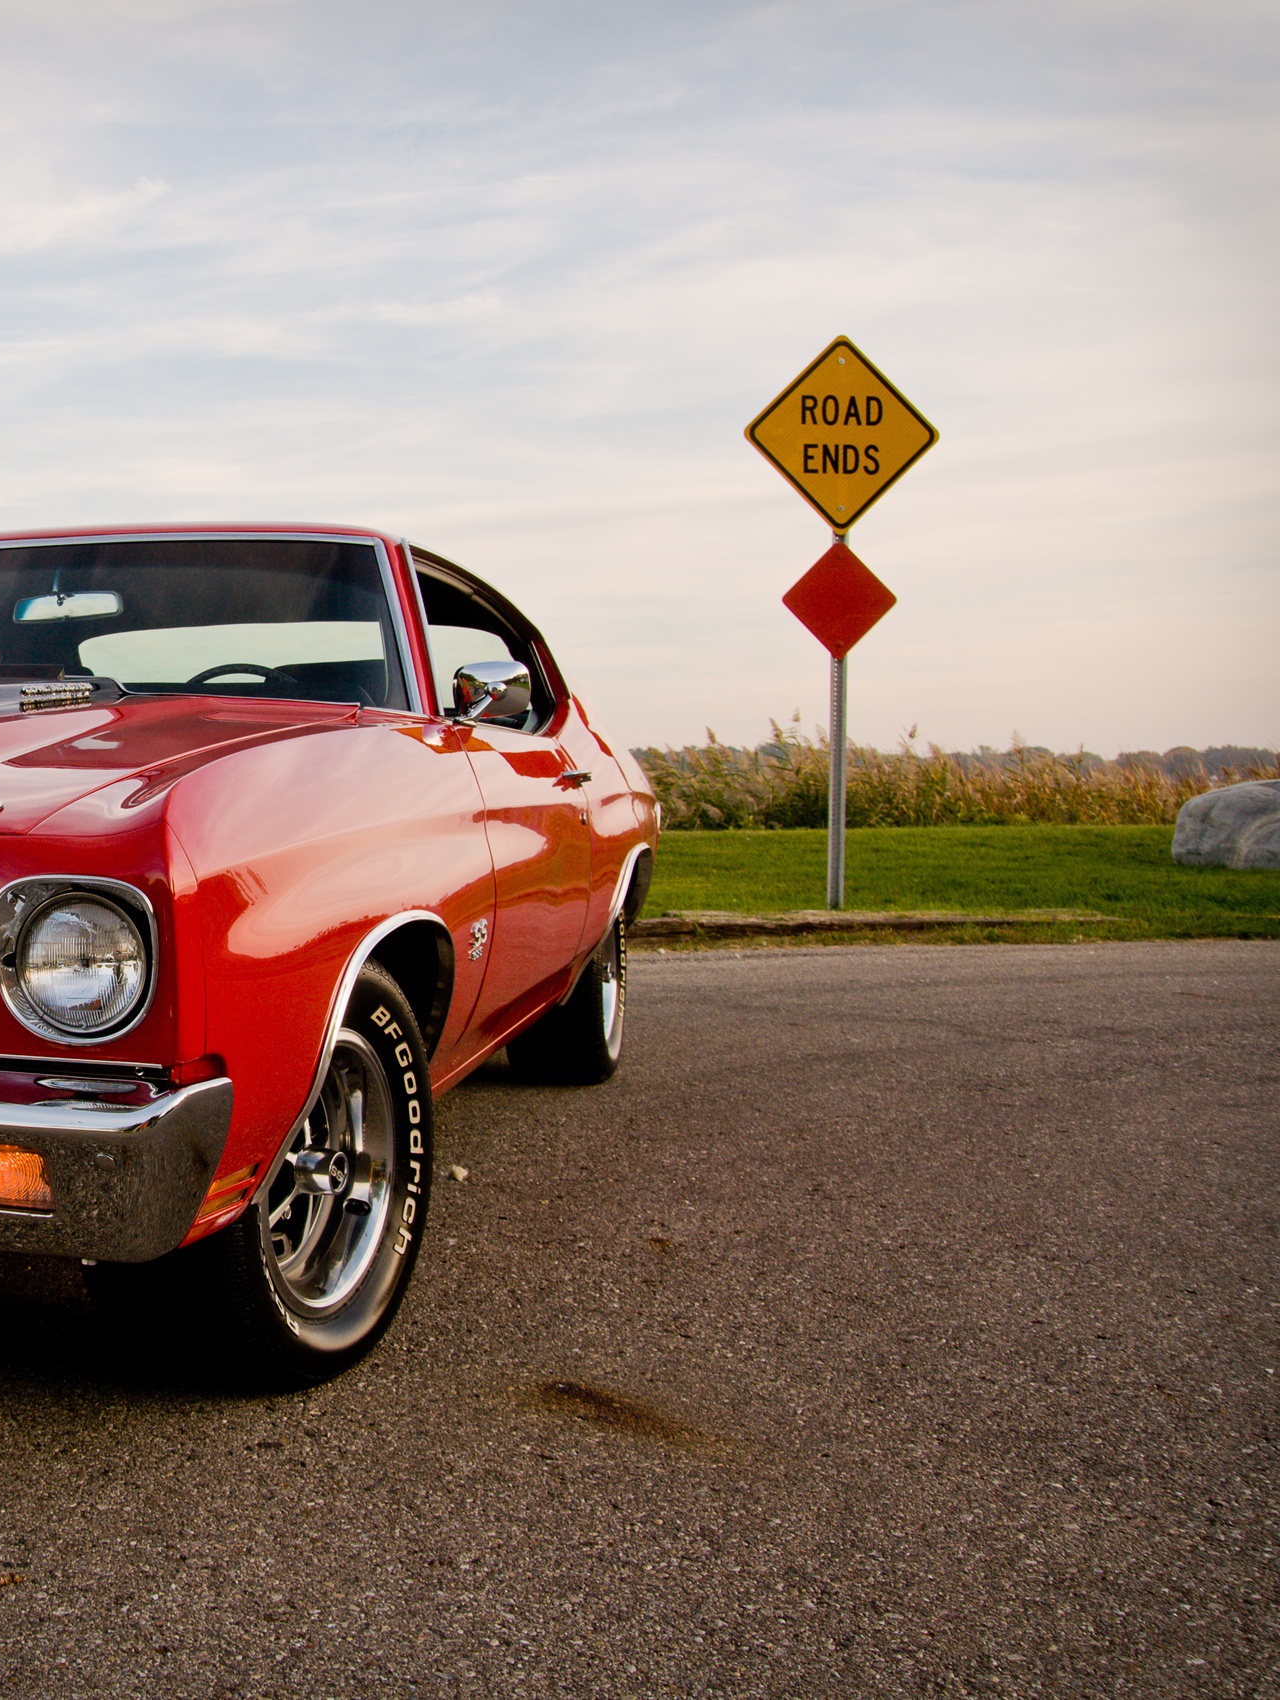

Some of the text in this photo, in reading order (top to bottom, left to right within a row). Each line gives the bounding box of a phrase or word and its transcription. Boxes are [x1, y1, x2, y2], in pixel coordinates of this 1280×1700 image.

[800, 395, 883, 426] ROAD
[803, 444, 880, 475] ENDS
[370, 1004, 424, 1255] BFGoodrich
[330, 1164, 344, 1182] SS
